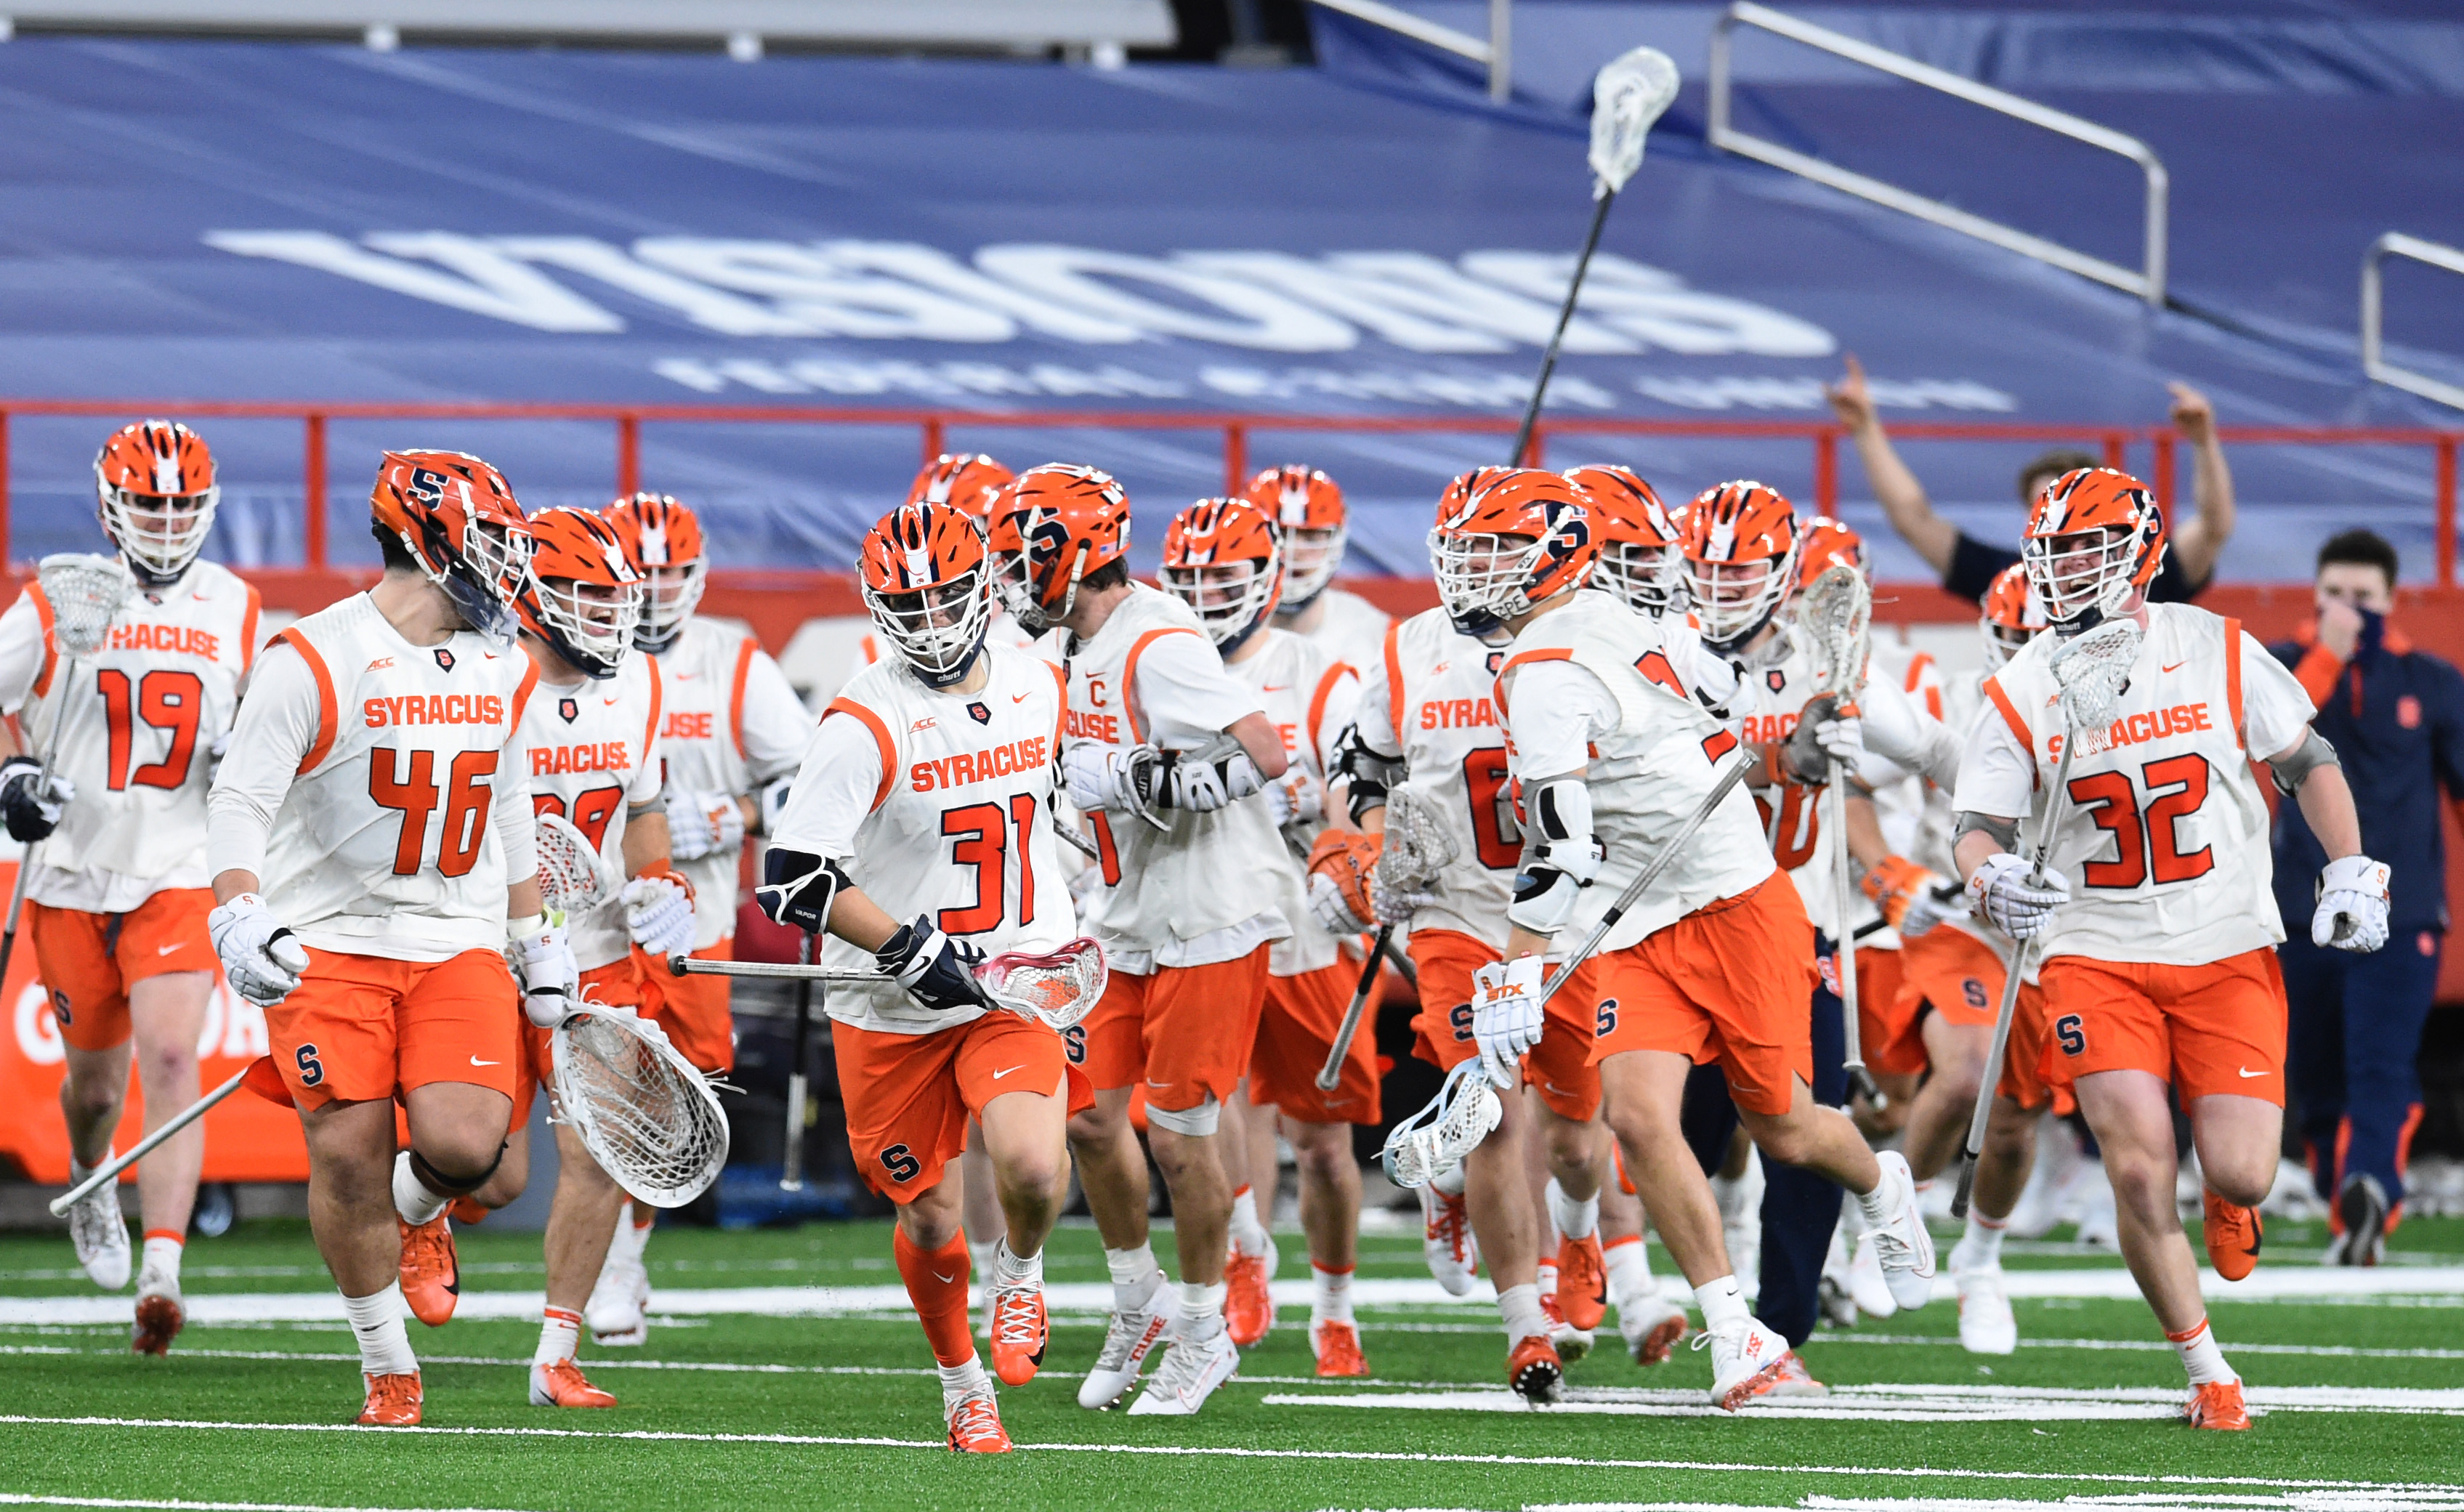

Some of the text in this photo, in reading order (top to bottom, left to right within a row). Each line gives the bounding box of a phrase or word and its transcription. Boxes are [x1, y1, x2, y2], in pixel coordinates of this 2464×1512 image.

[200, 227, 1837, 357] VISIONS
[405, 466, 448, 512] S
[1012, 506, 1072, 566] S
[1543, 501, 1590, 561] S
[365, 656, 395, 673] ACC
[364, 695, 504, 729] SYRACUS
[1091, 680, 1107, 708] C
[1421, 698, 1499, 730] SYRA
[97, 669, 203, 791] 19
[910, 716, 937, 734] ACC
[527, 741, 631, 777] RACUSE
[910, 735, 1046, 792] SYRACUSE
[368, 747, 499, 878] 46
[2067, 752, 2215, 890] 32
[937, 791, 1037, 935] 31
[2377, 869, 2386, 885] S
[794, 908, 817, 921] VAPOR
[54, 988, 73, 1027] S
[1485, 982, 1524, 1003] STX
[1963, 977, 1990, 1011] S
[1452, 1003, 1474, 1043] S
[1596, 997, 1620, 1039] S
[2054, 1014, 2087, 1057] S
[294, 1043, 326, 1087] S
[1065, 1024, 1088, 1065] S
[879, 1143, 921, 1184] S
